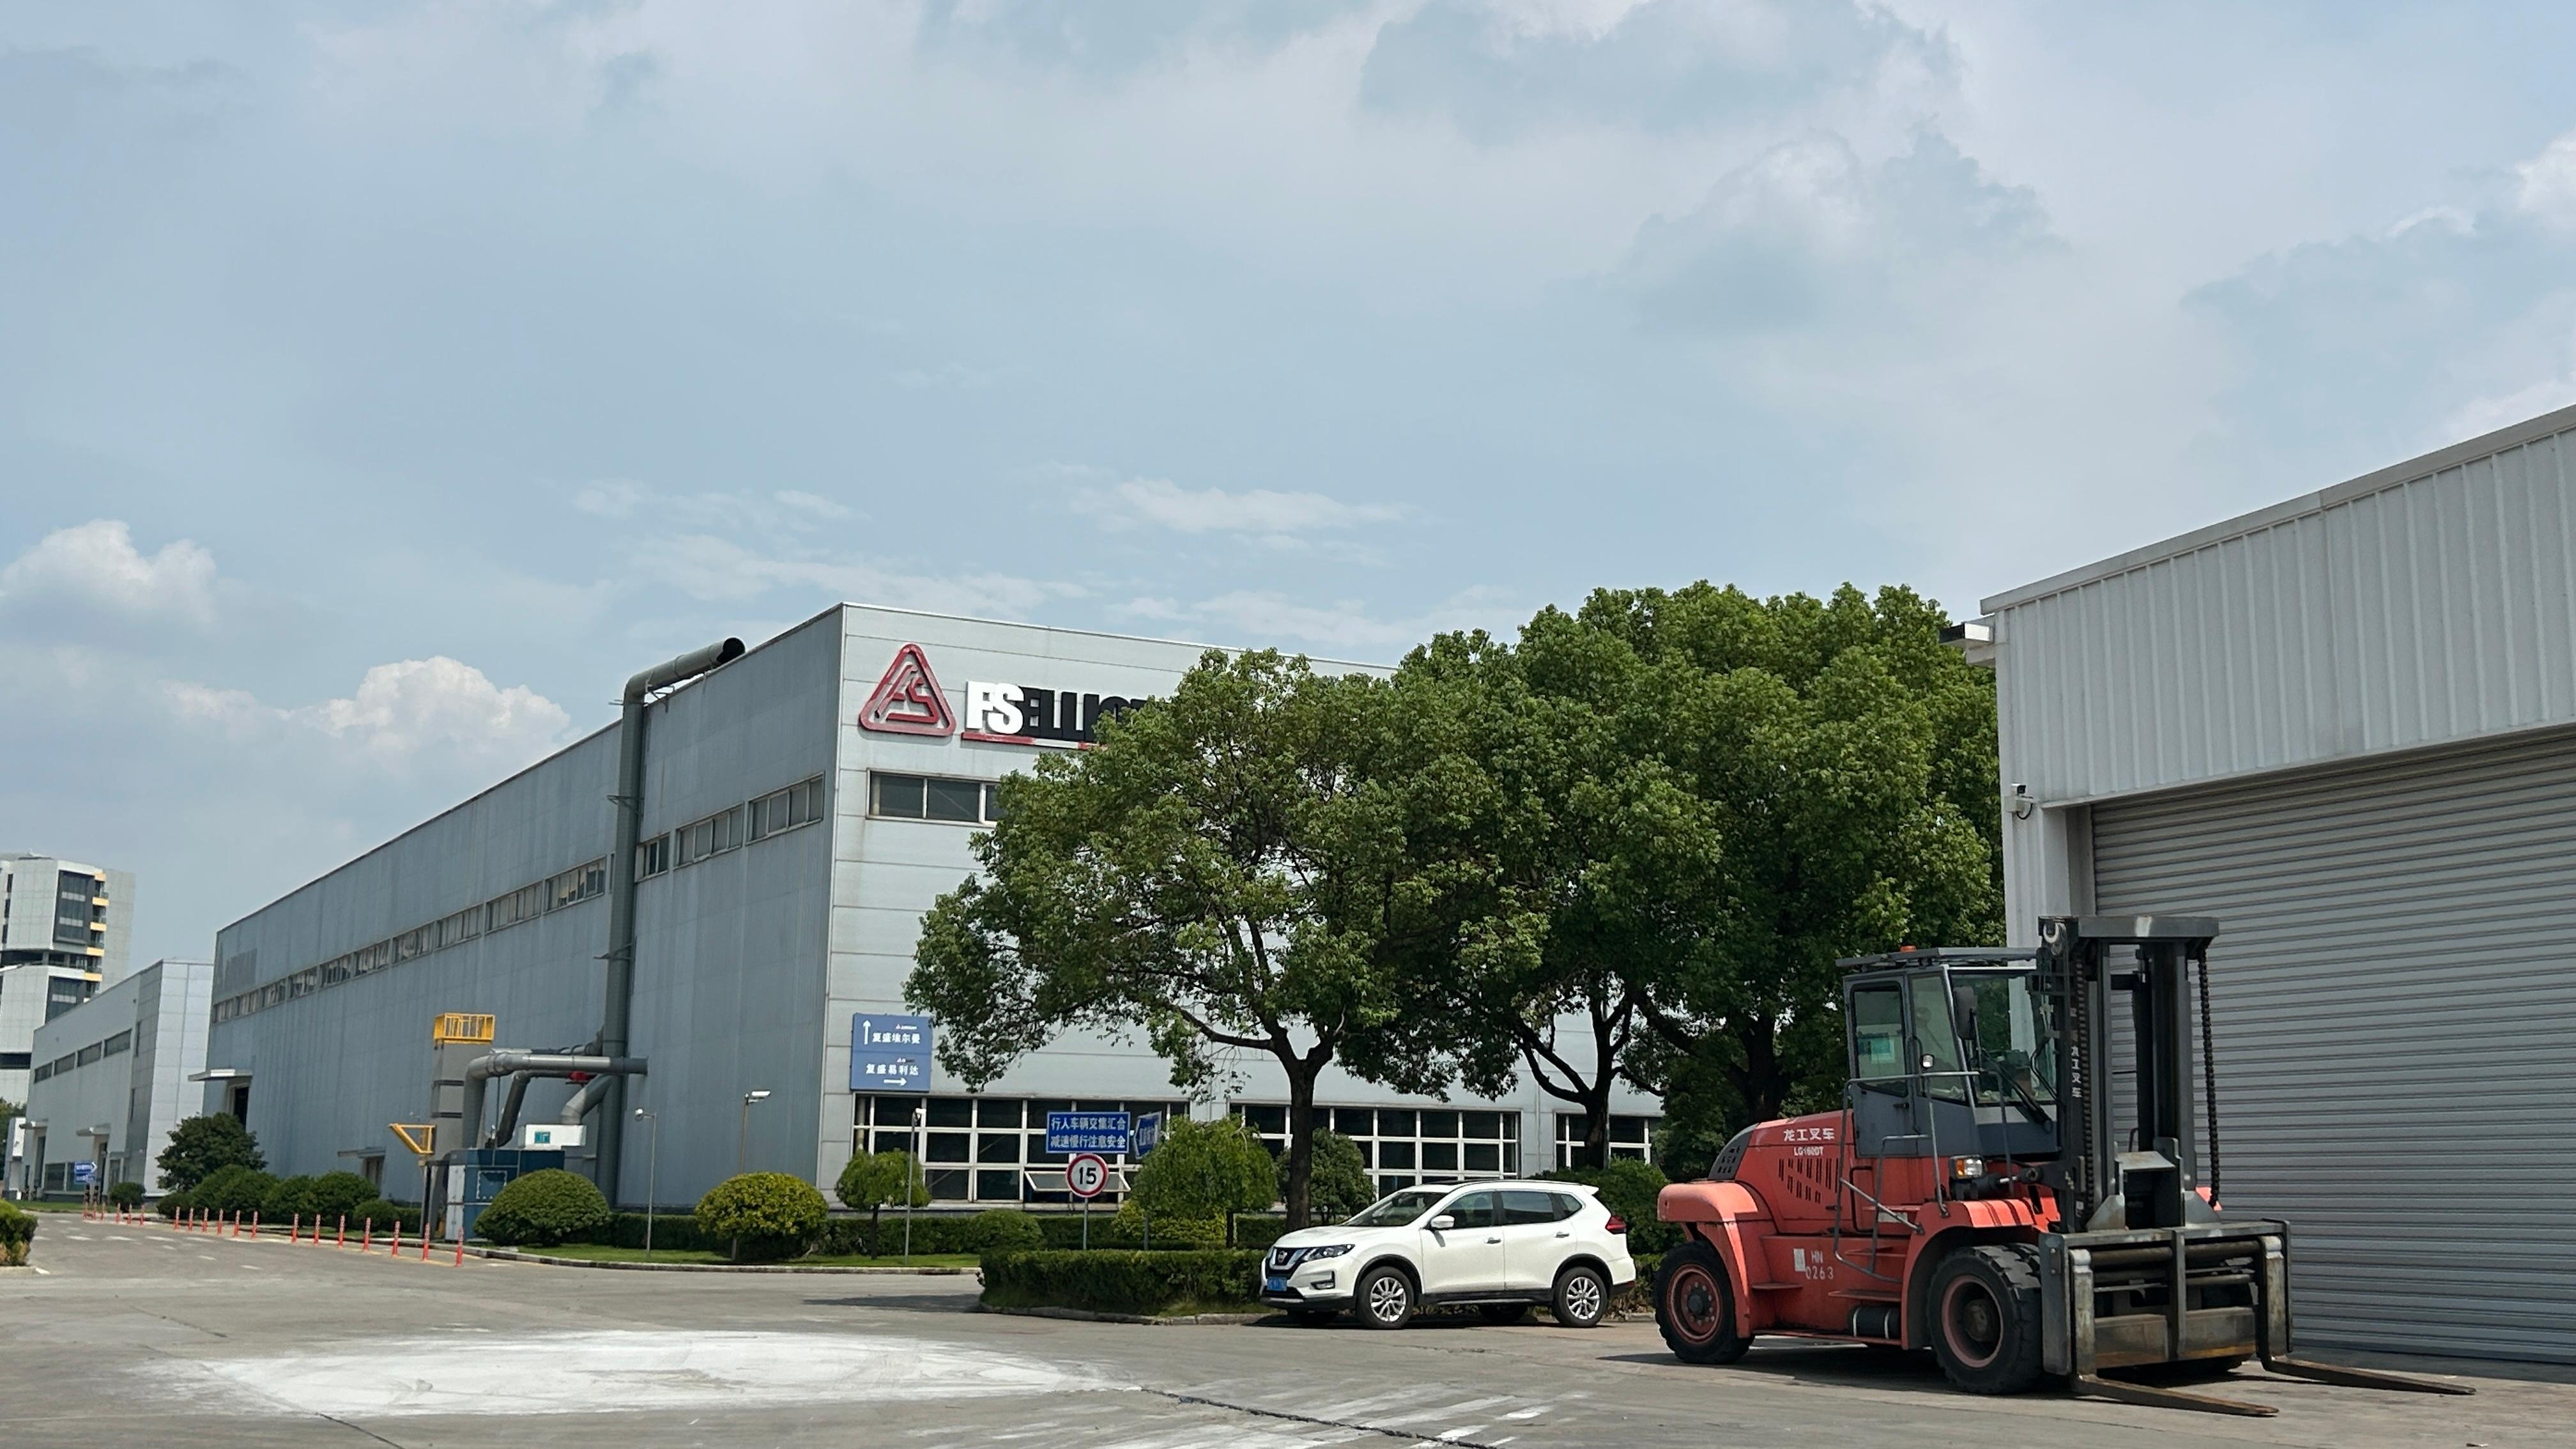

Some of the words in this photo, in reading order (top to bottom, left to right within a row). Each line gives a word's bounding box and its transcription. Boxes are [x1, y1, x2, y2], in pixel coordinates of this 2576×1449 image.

[1050, 1134, 1126, 1148] 减速慢行注意安全
[1783, 1128, 1836, 1142] 龙工叉车
[1079, 1167, 1097, 1184] 15
[1805, 1266, 1834, 1280] 0263
